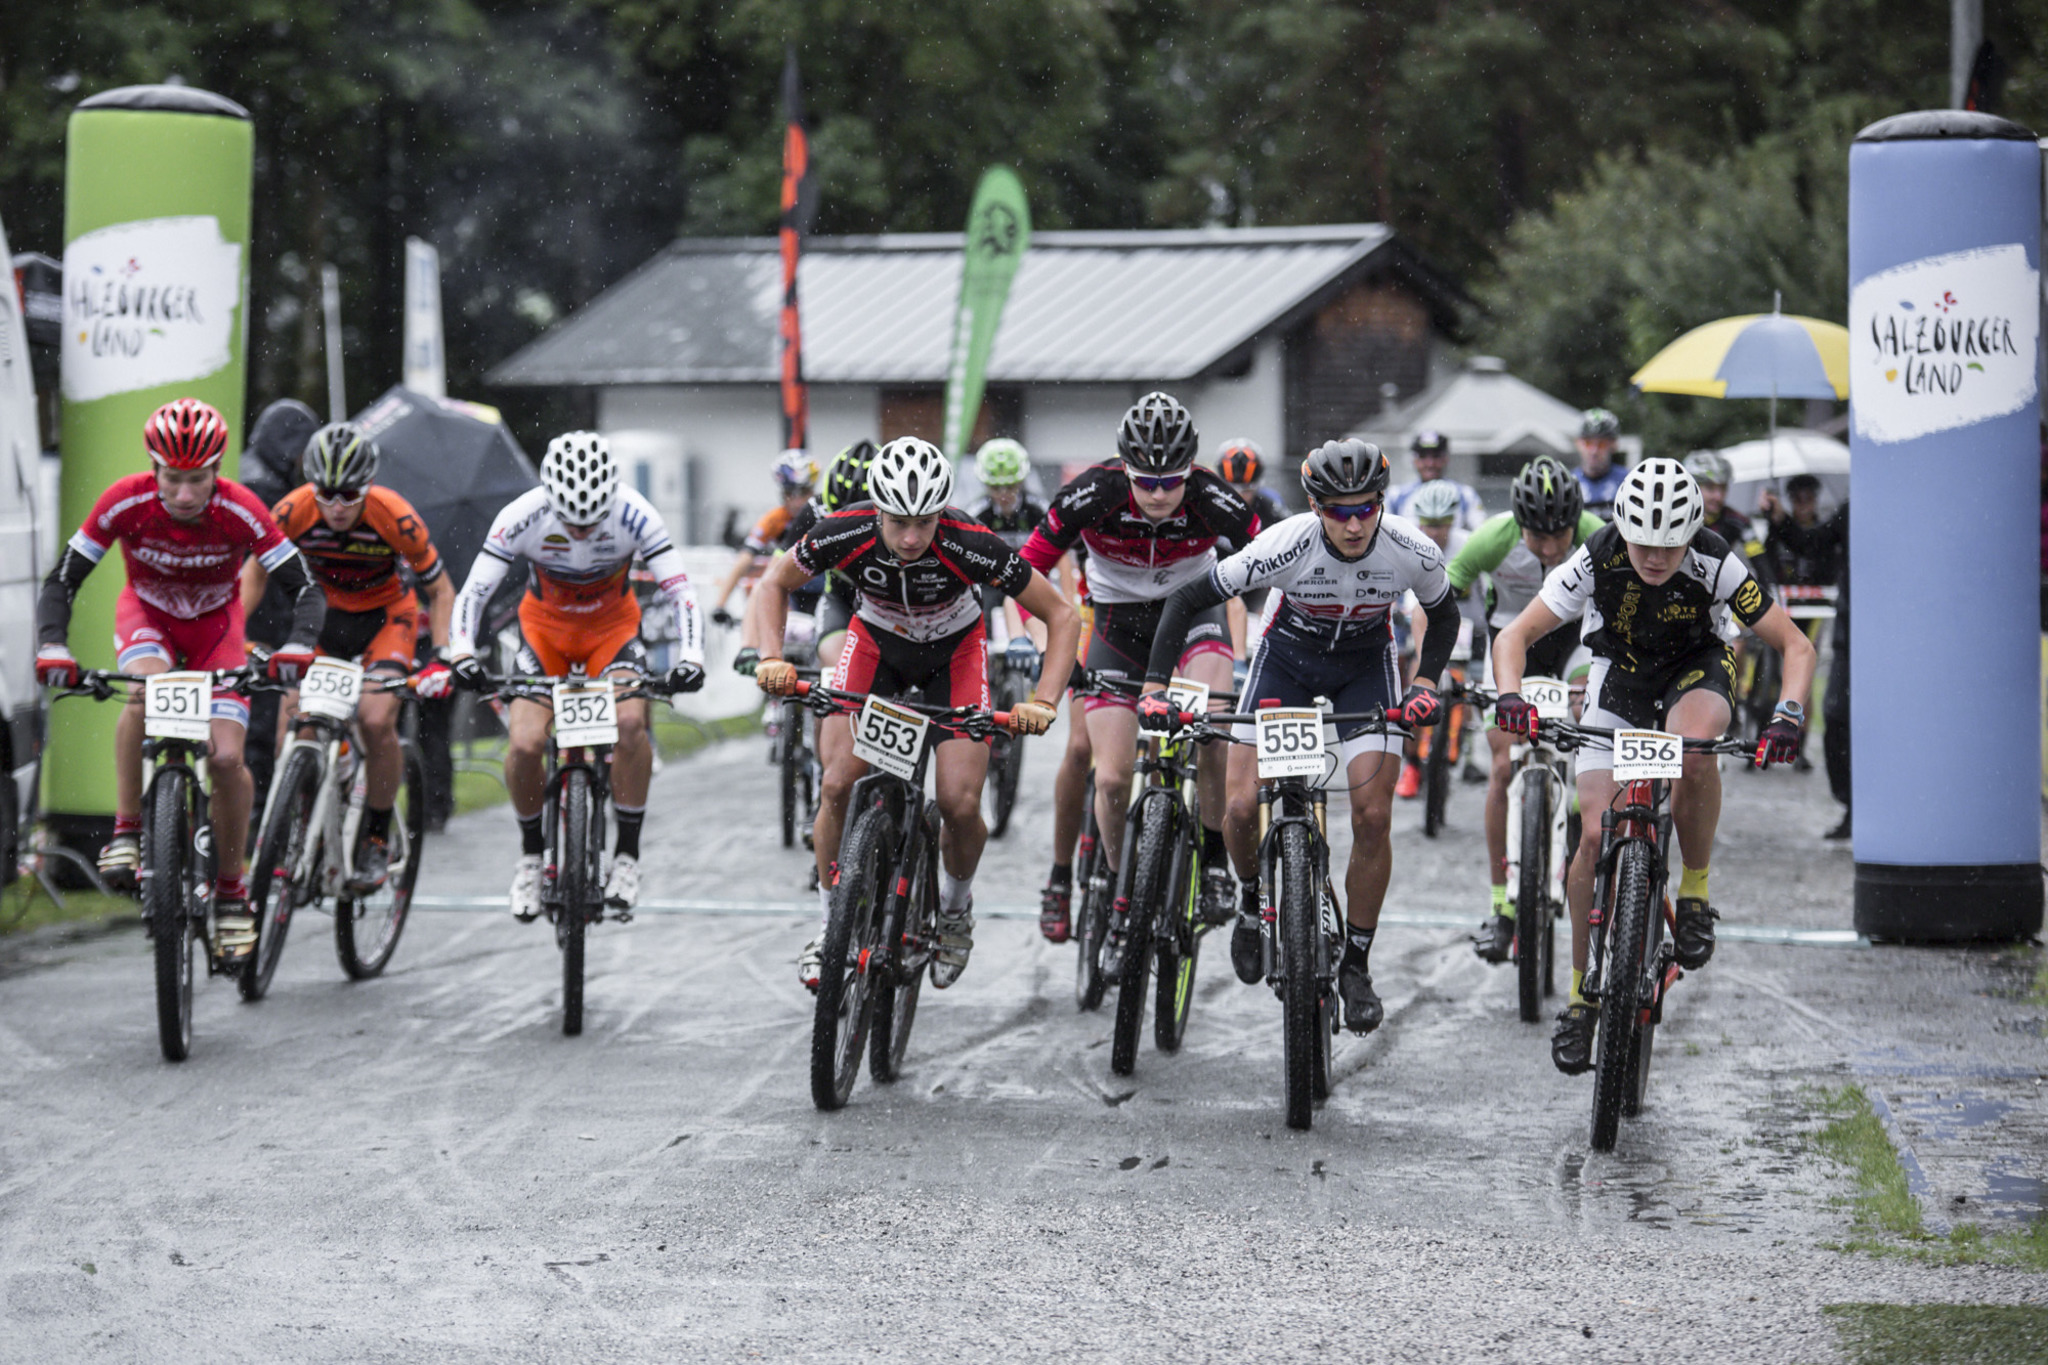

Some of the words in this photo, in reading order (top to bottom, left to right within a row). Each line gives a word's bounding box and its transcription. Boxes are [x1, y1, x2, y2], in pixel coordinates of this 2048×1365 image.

[1905, 354, 1963, 394] LAND
[1390, 528, 1436, 557] Radsport
[965, 550, 998, 571] sport
[308, 670, 354, 698] 558
[154, 686, 200, 716] 551
[562, 694, 609, 725] 552
[864, 712, 918, 757] 553
[1264, 722, 1318, 754] 555
[1621, 739, 1676, 761] 556
